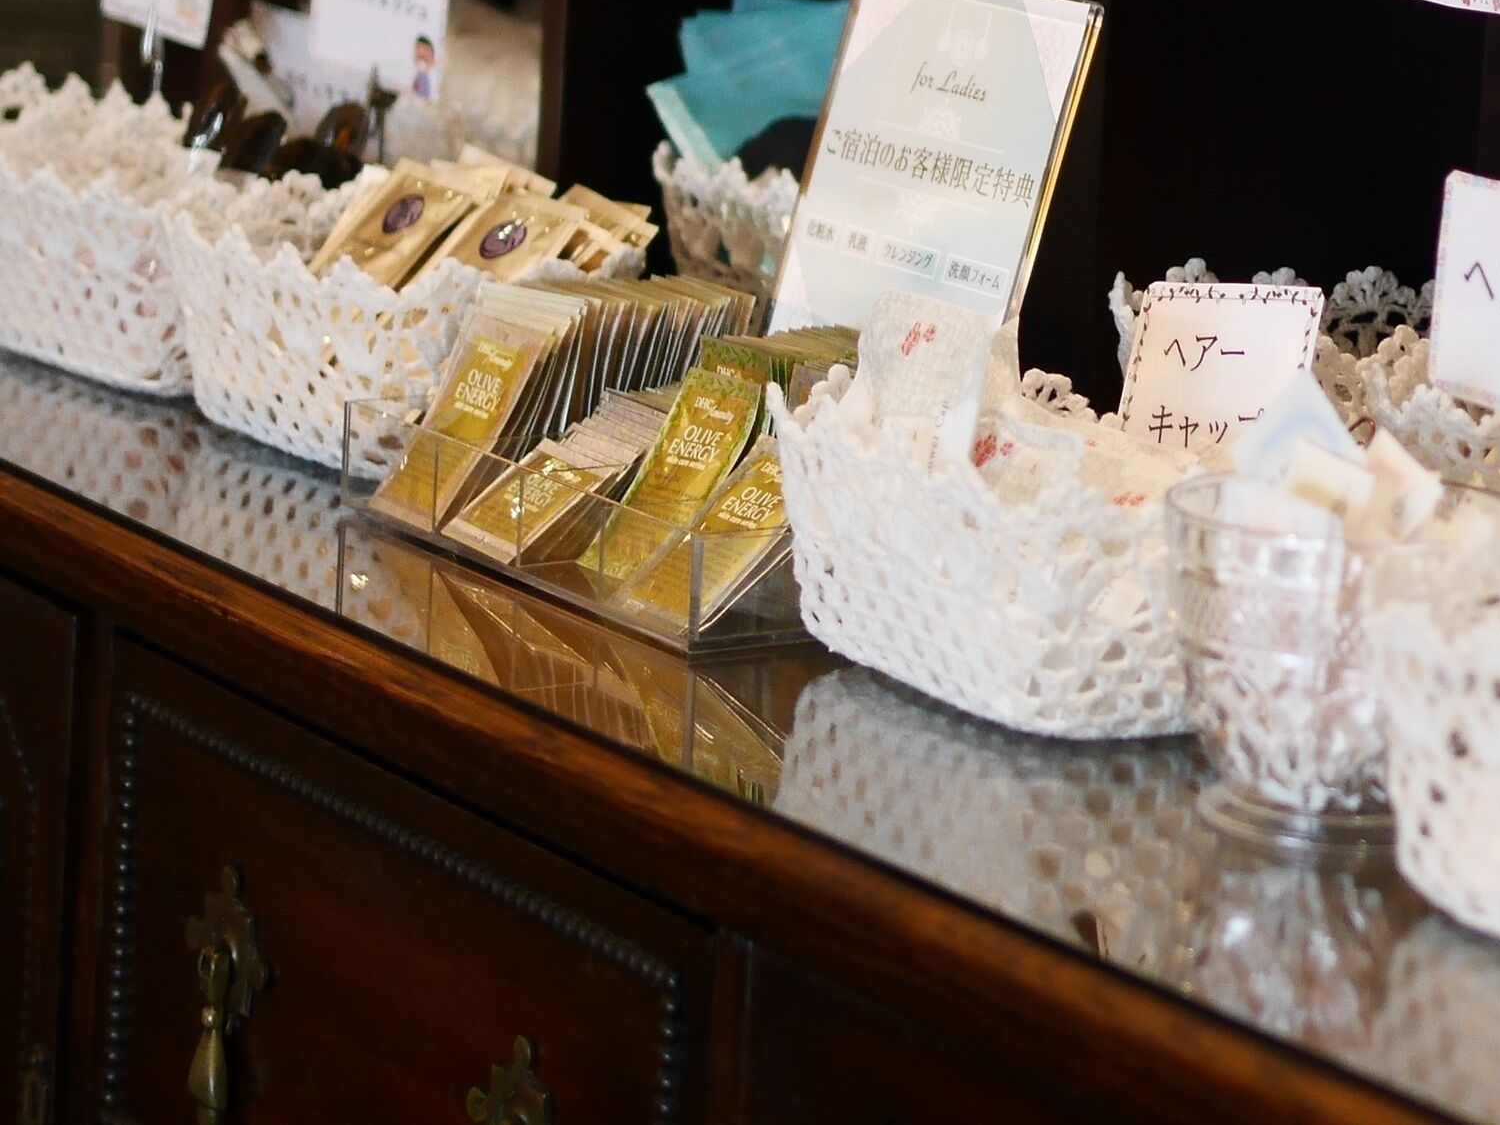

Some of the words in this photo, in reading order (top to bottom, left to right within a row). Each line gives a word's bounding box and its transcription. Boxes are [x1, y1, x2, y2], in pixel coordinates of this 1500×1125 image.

[910, 61, 934, 93] for
[936, 70, 988, 102] Ladies
[826, 128, 1036, 208] ご宿泊のお客様限定特典
[884, 243, 935, 269] クレンジング
[947, 261, 1000, 290] 洗顔フォーム
[1163, 334, 1246, 372] ヘアー
[467, 368, 503, 395] OLIVE
[455, 382, 502, 412] ENERGY
[684, 425, 723, 447] OLIVE
[667, 438, 720, 463] ENERGY
[721, 496, 776, 523] ENERGY
[741, 486, 783, 508] OLIVE
